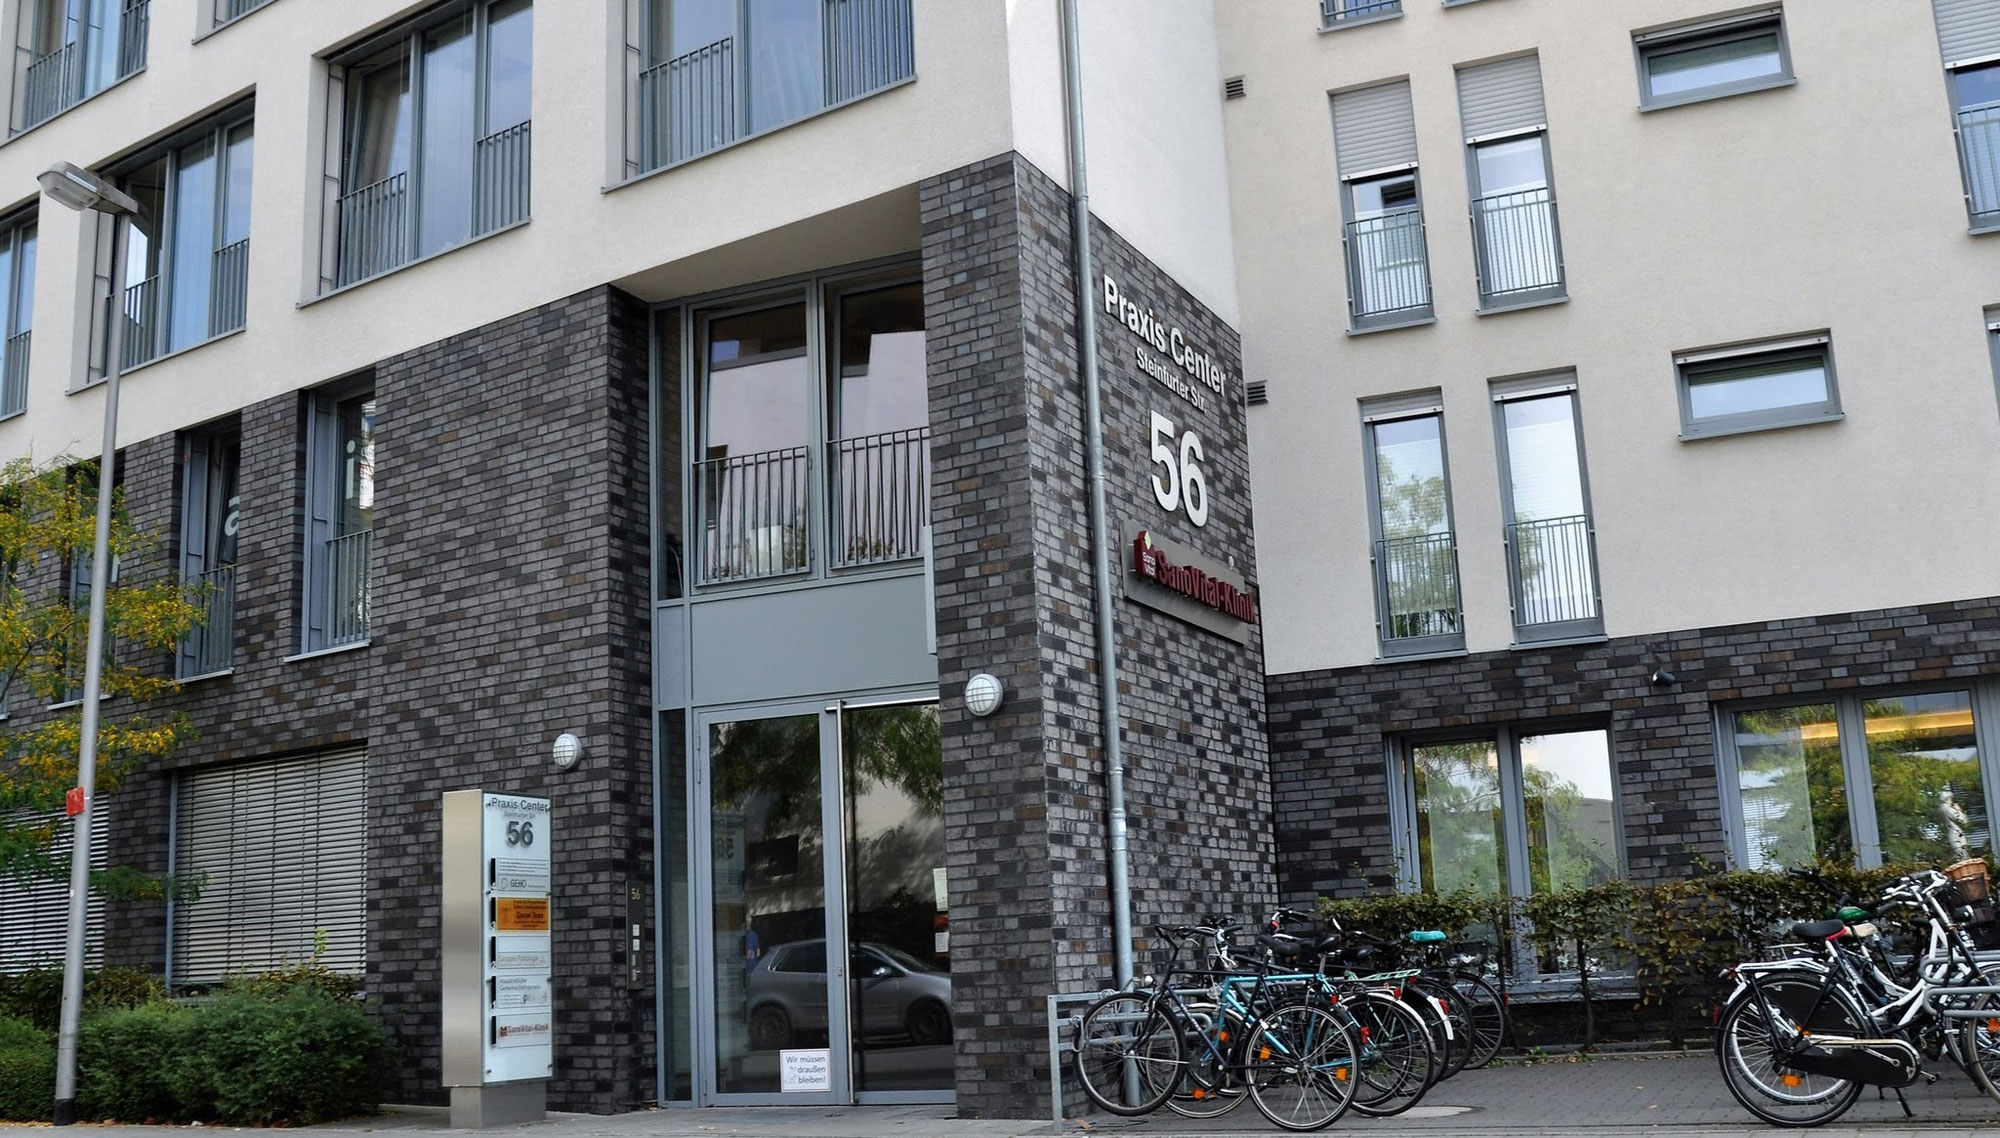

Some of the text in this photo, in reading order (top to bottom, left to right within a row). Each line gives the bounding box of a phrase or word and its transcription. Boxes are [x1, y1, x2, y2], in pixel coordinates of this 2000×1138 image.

[1104, 274, 1226, 397] Praxis Center
[1136, 347, 1189, 400] Steinfurter
[1151, 409, 1208, 527] 56
[491, 797, 548, 812] Praxis Center
[507, 821, 534, 847] 56
[631, 888, 641, 900] 56
[797, 1065, 825, 1073] draußen
